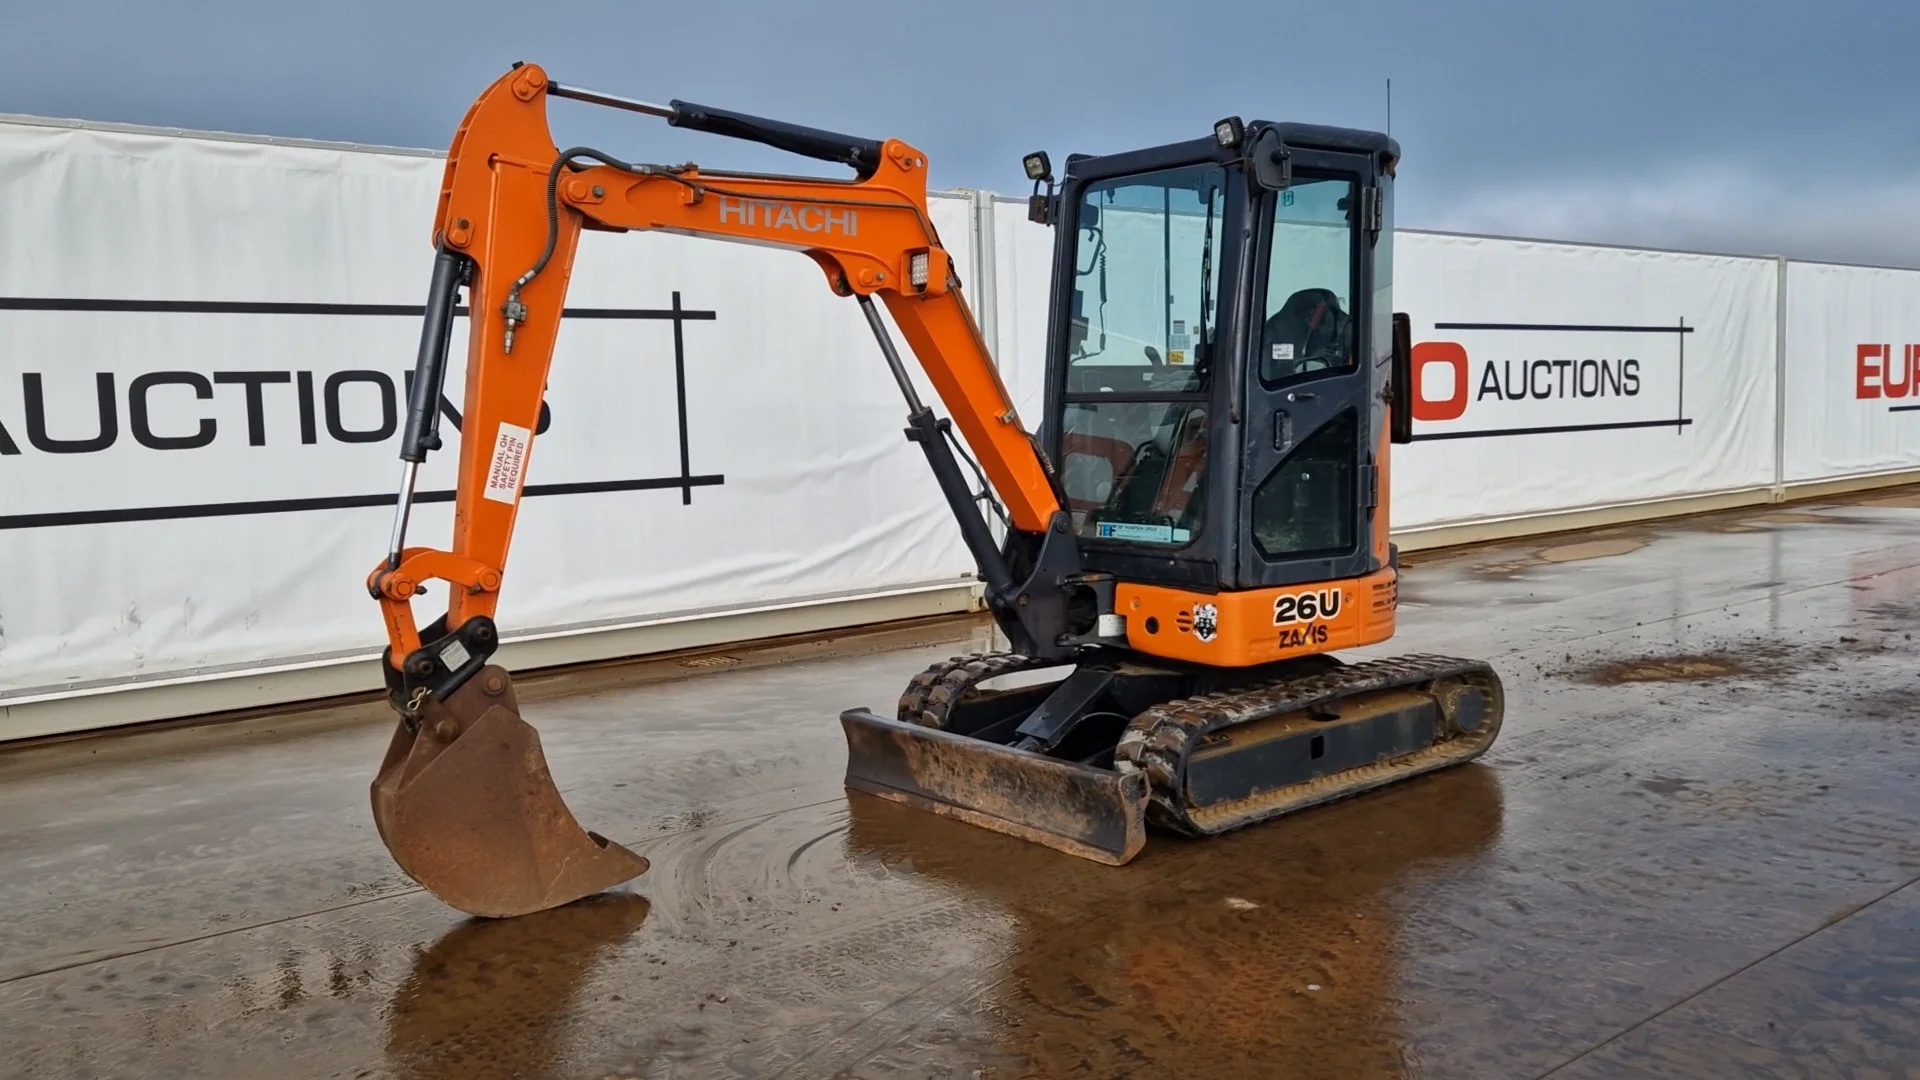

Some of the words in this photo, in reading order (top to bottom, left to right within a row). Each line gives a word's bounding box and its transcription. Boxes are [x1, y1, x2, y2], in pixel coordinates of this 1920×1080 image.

[719, 196, 858, 237] HITACHI
[1476, 358, 1641, 402] AUCTIONS
[1856, 343, 1920, 400] EU
[0, 369, 552, 456] UCTIO
[490, 450, 506, 489] MANUAL
[499, 434, 509, 448] QH
[498, 454, 512, 490] SAFETY
[507, 436, 517, 453] PIN
[507, 442, 524, 489] REQUIRED
[1274, 589, 1340, 624] 26U
[1279, 622, 1329, 649] ZAXIS
